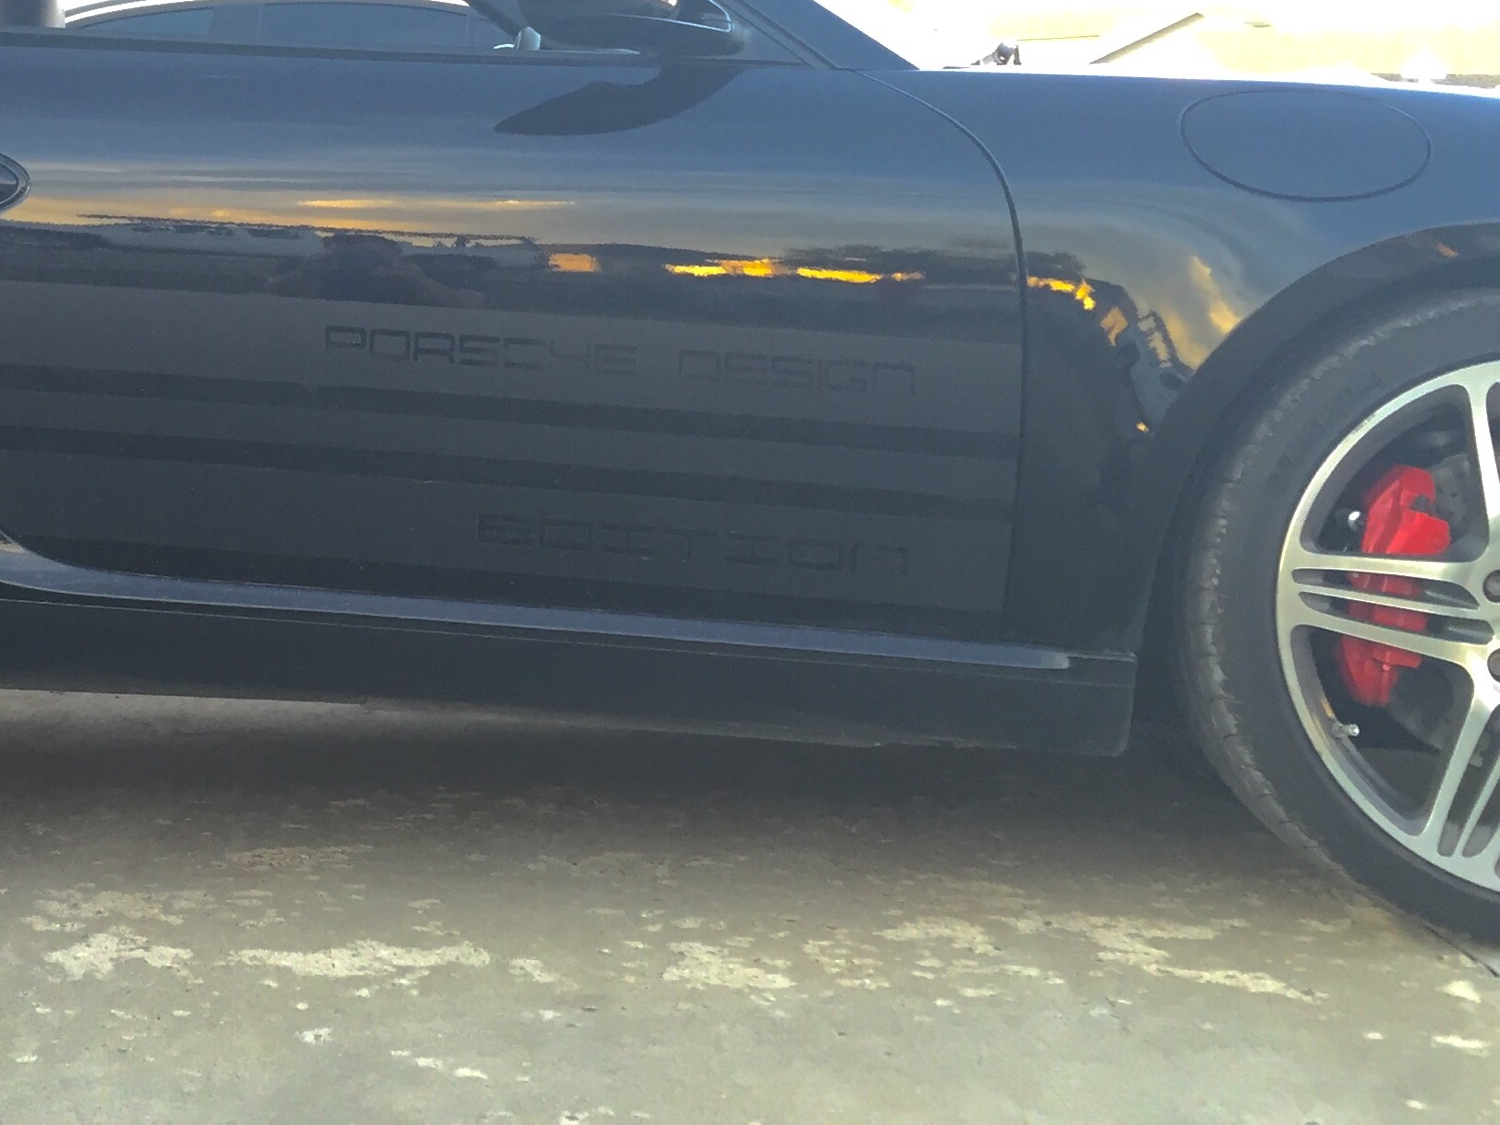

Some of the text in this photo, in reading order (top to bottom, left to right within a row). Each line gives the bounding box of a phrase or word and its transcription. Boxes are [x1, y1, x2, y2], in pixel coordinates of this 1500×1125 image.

[325, 326, 916, 395] PORSCHE DESIGN
[477, 513, 908, 574] EDITION
